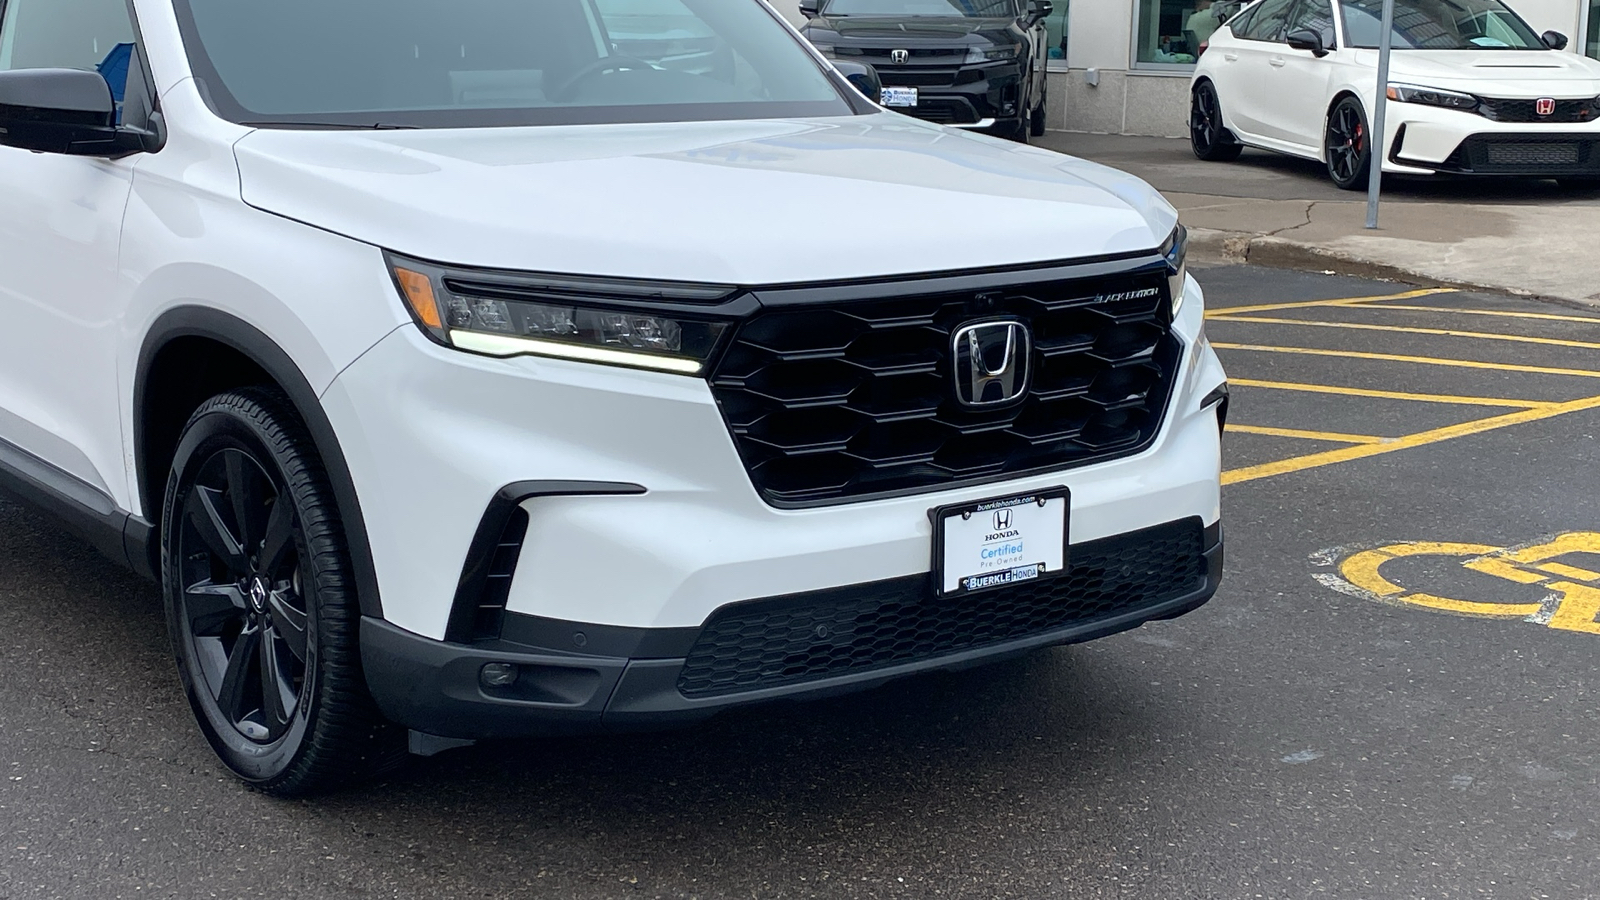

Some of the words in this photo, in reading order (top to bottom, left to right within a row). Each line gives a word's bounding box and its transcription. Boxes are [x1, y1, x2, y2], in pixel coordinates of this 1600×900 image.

[977, 496, 1036, 511] buerklehonda.com
[984, 530, 1019, 541] HONDA
[980, 541, 1023, 559] Certified
[970, 571, 1011, 588] BUERKLE
[1012, 568, 1036, 580] HONDA
